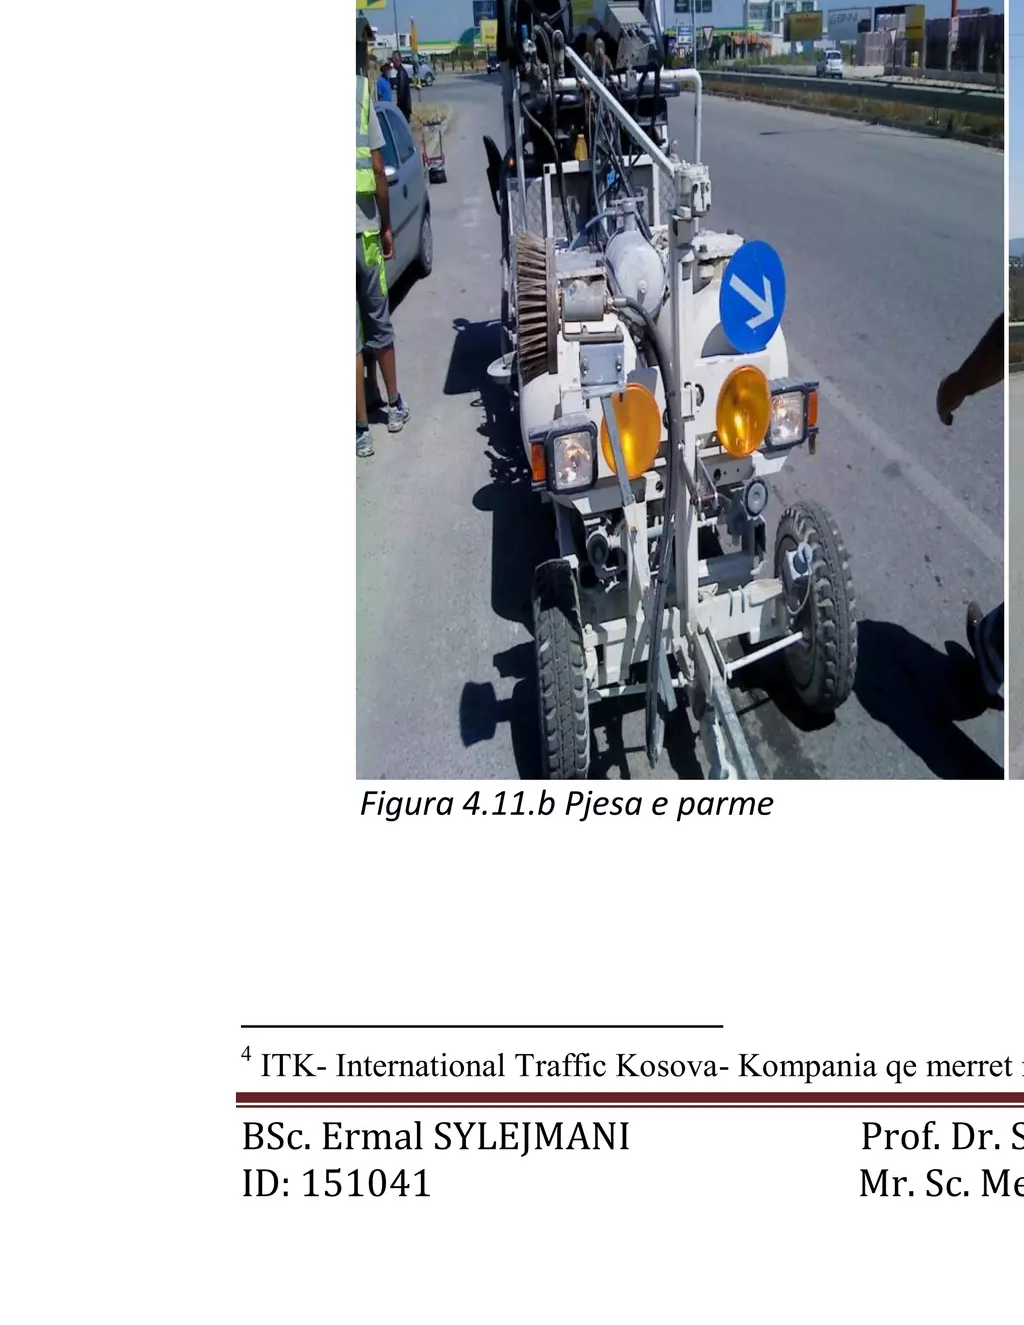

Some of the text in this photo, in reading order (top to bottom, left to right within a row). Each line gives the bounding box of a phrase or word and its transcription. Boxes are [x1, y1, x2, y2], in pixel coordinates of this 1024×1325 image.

[361, 789, 773, 821] Figura 4.11.b Pjesa e parme
[241, 1046, 251, 1061] 4
[261, 1054, 326, 1076] ITK-
[336, 1053, 505, 1077] International
[515, 1053, 606, 1077] Traffic
[616, 1054, 728, 1077] Kosova-
[739, 1053, 877, 1083] Kompania
[886, 1061, 916, 1083] qe
[927, 1056, 1013, 1077] merret
[243, 1121, 629, 1157] BSc. Ermal SYLEJMANI
[862, 1121, 939, 1150] Prof.
[952, 1122, 999, 1150] Dr.
[243, 1168, 430, 1197] ID: 151041
[860, 1169, 913, 1197] Mr.
[927, 1169, 968, 1197] Sc.
